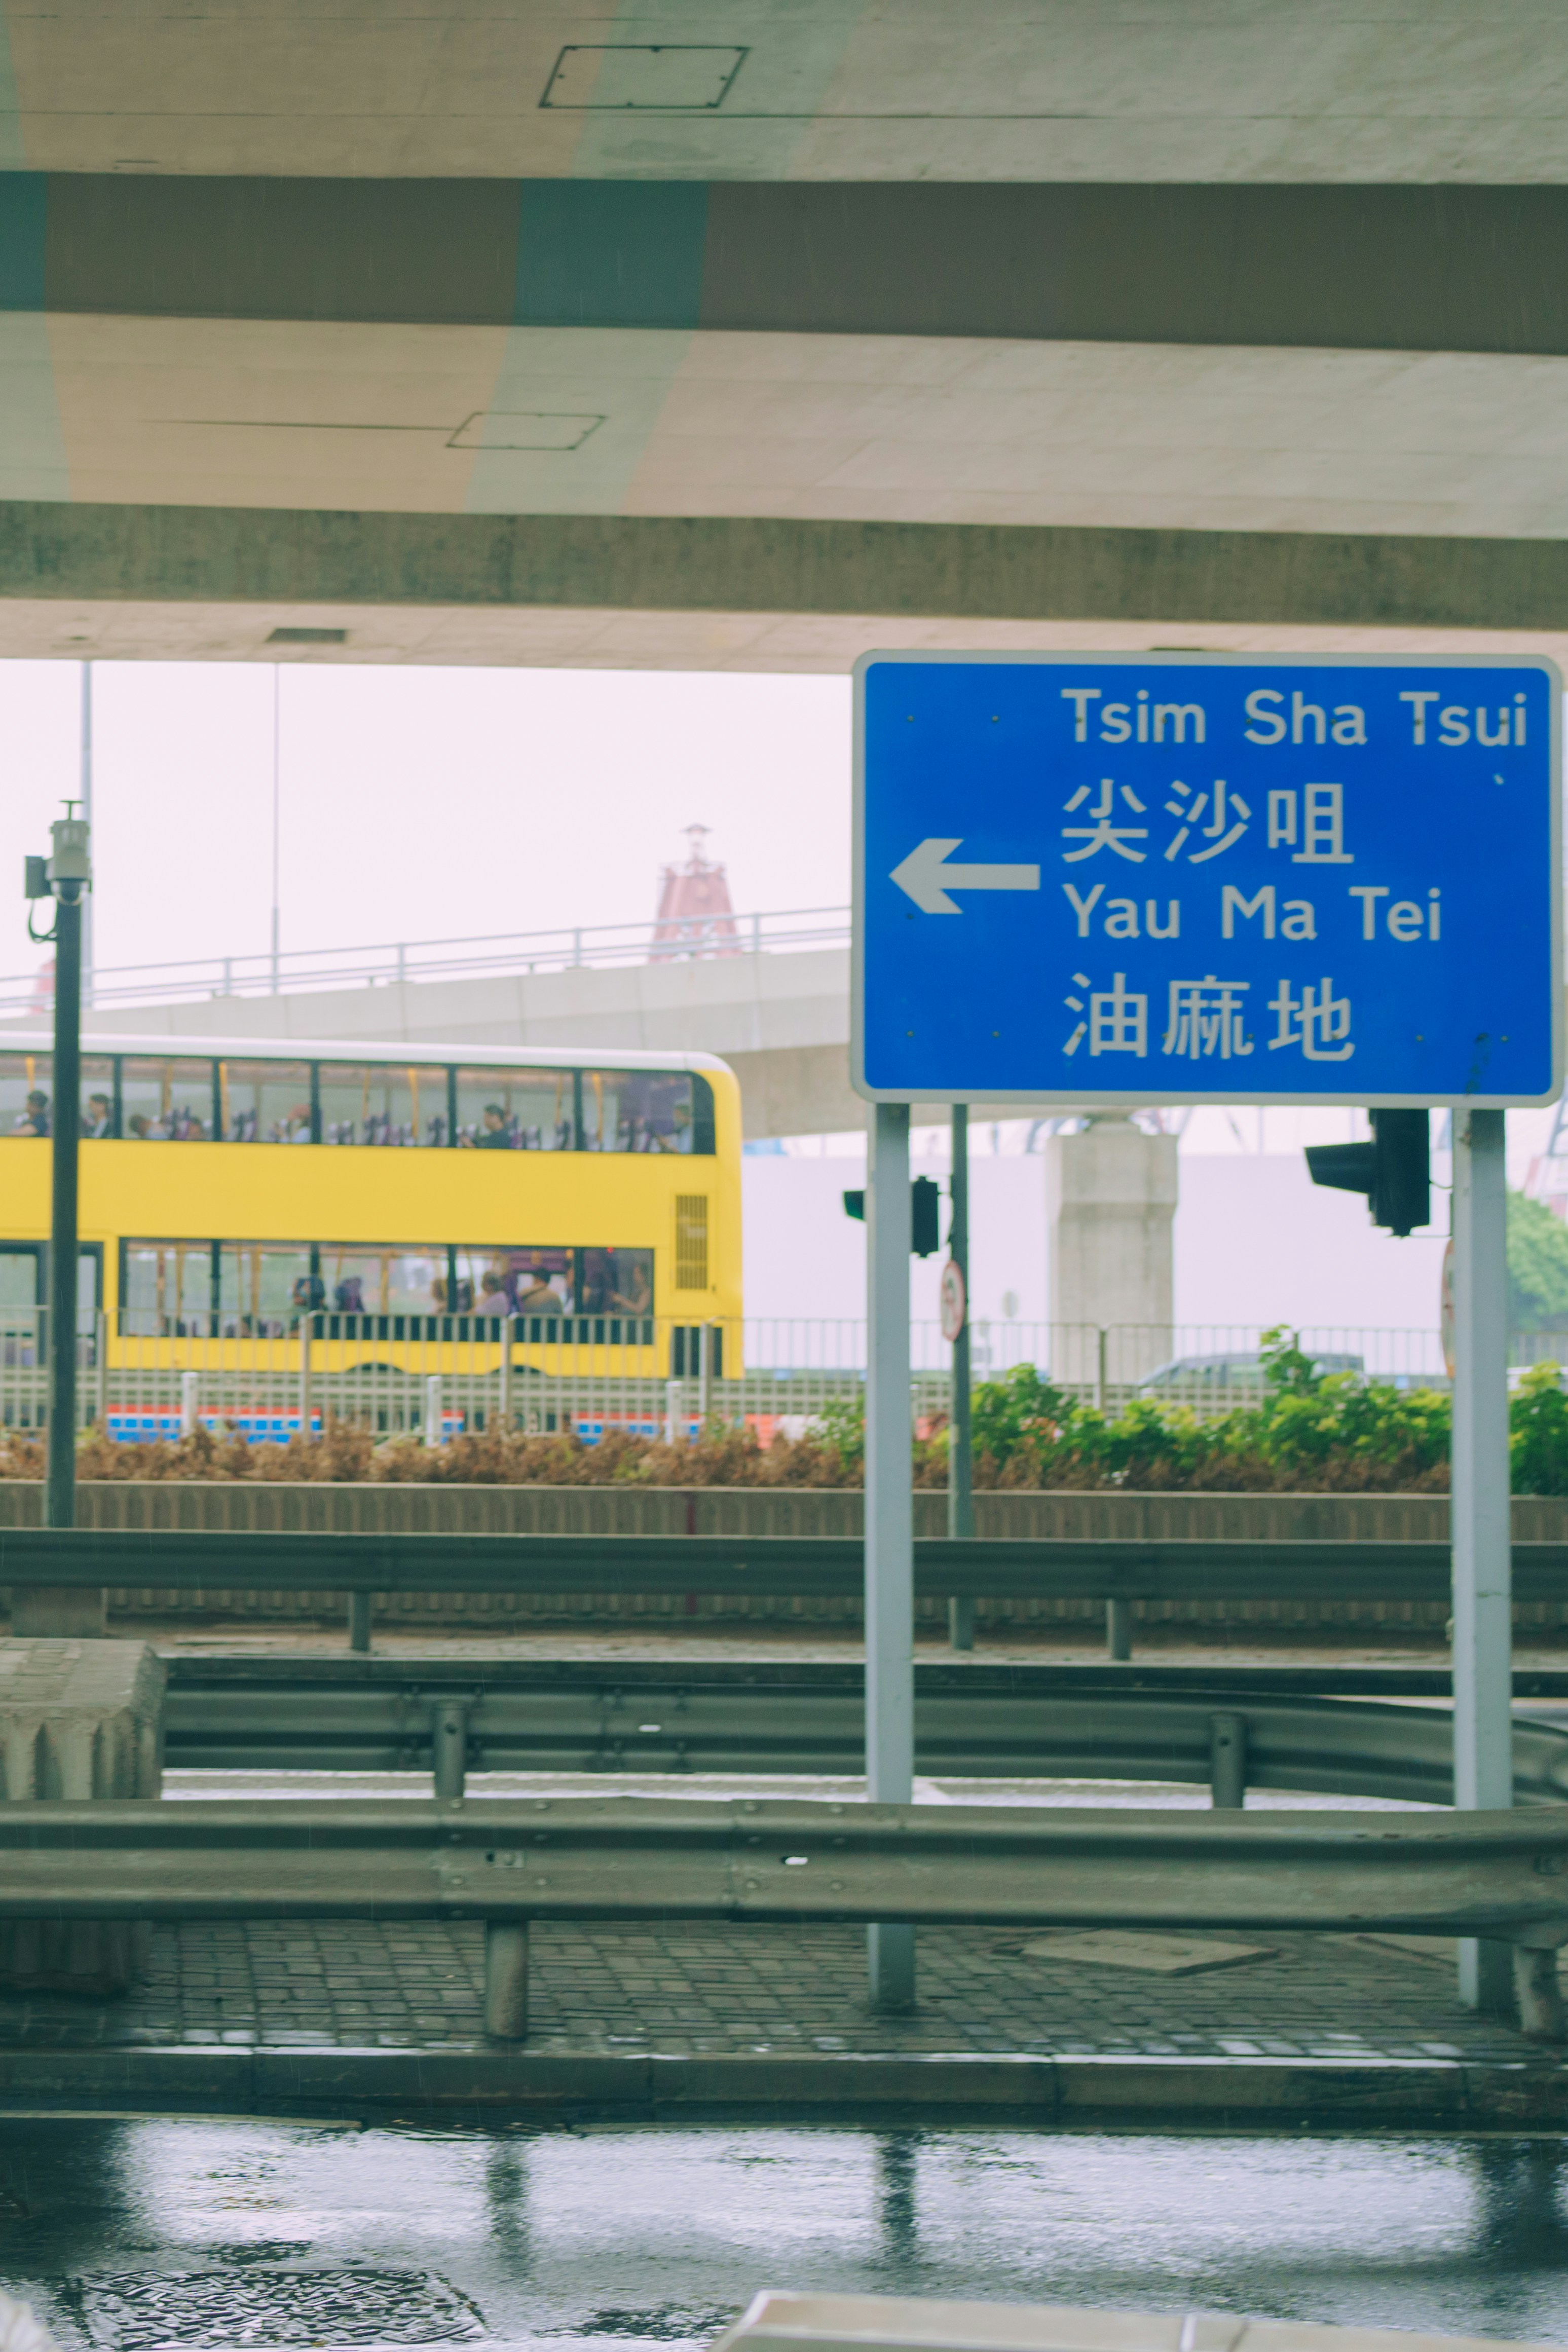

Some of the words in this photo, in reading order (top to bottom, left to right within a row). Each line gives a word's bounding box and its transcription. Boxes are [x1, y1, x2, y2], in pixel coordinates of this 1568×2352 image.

[1061, 689, 1205, 743] Tsim
[1244, 689, 1367, 745] Sha
[1399, 691, 1526, 746] Tsui
[1062, 778, 1354, 864] 尖沙咀
[1062, 883, 1180, 939] Yau
[1222, 885, 1318, 941] Ma
[1349, 886, 1441, 942] Tei
[1062, 972, 1356, 1061] 油麻地
